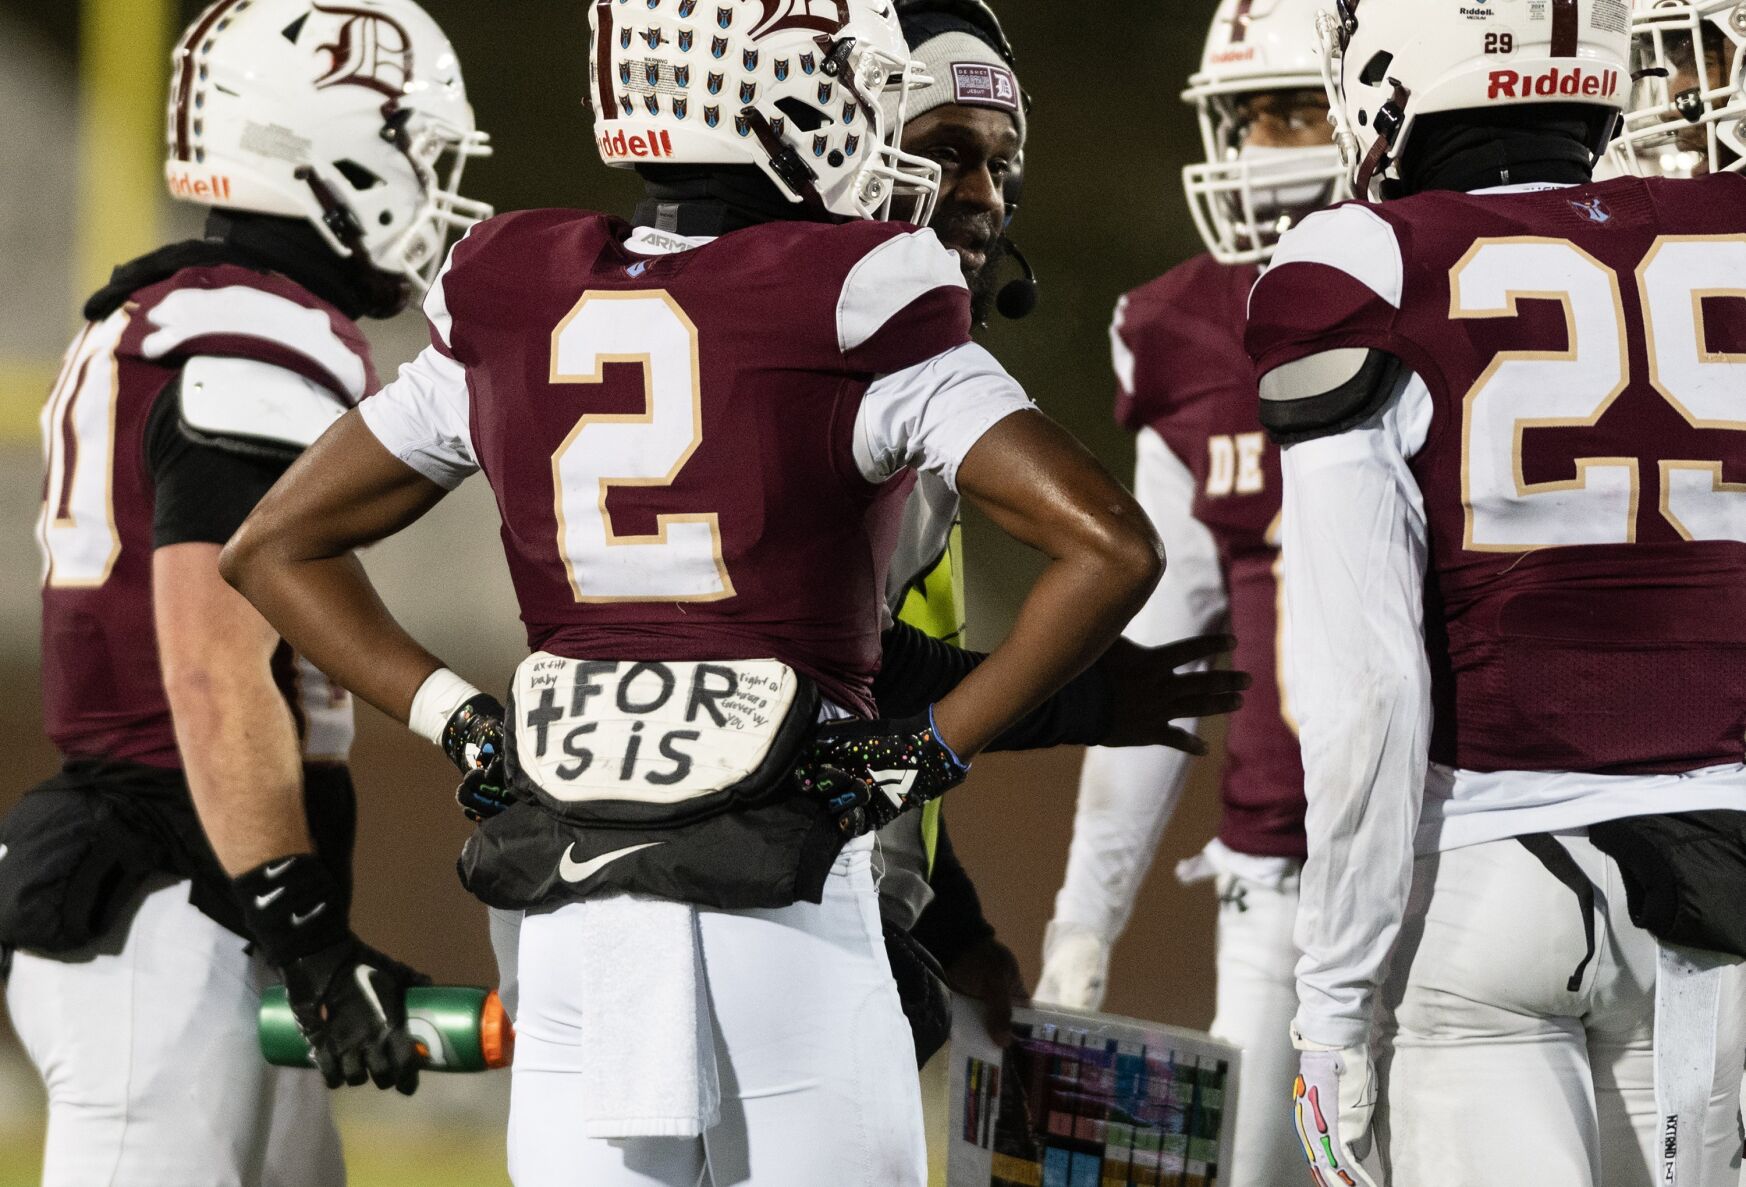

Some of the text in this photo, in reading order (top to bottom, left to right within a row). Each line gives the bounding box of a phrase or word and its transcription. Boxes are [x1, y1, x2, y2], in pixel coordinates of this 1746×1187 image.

[1460, 7, 1495, 17] Riddell
[643, 57, 669, 65] WARNING
[1484, 33, 1513, 54] 29
[1487, 67, 1619, 99] Riddell
[1448, 232, 1746, 553] 29
[549, 289, 737, 603] 2
[1205, 431, 1265, 497] DE
[569, 661, 738, 728] FOR
[1664, 1113, 1679, 1159] NXTRND
